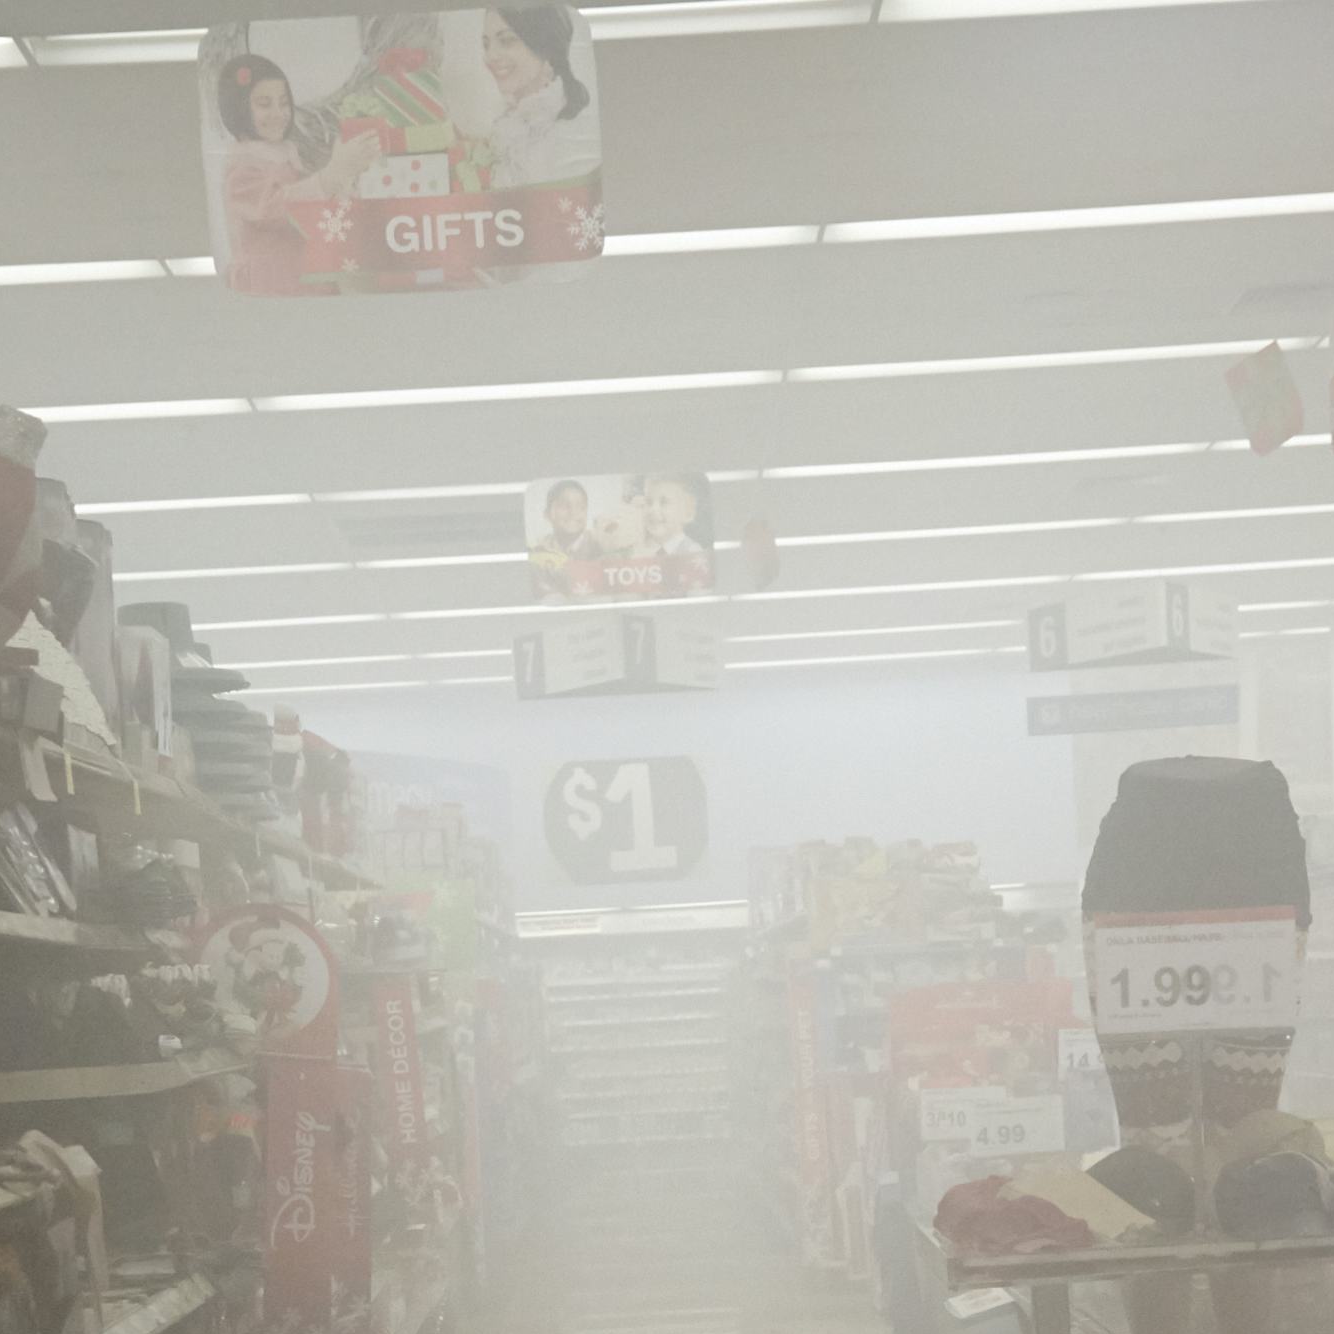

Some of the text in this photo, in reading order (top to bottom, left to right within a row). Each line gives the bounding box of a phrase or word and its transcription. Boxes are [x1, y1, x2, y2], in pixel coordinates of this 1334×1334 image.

[385, 209, 526, 254] GIFTS
[603, 565, 663, 586] TOYS
[1039, 615, 1057, 659] 6
[1172, 594, 1185, 636] 6
[522, 640, 537, 684] 7
[630, 620, 646, 666] 7
[563, 761, 679, 873] $1
[1110, 963, 1212, 1009] 1.99
[385, 999, 417, 1144] HOME DÉCOR
[975, 1122, 1027, 1147] 4.99
